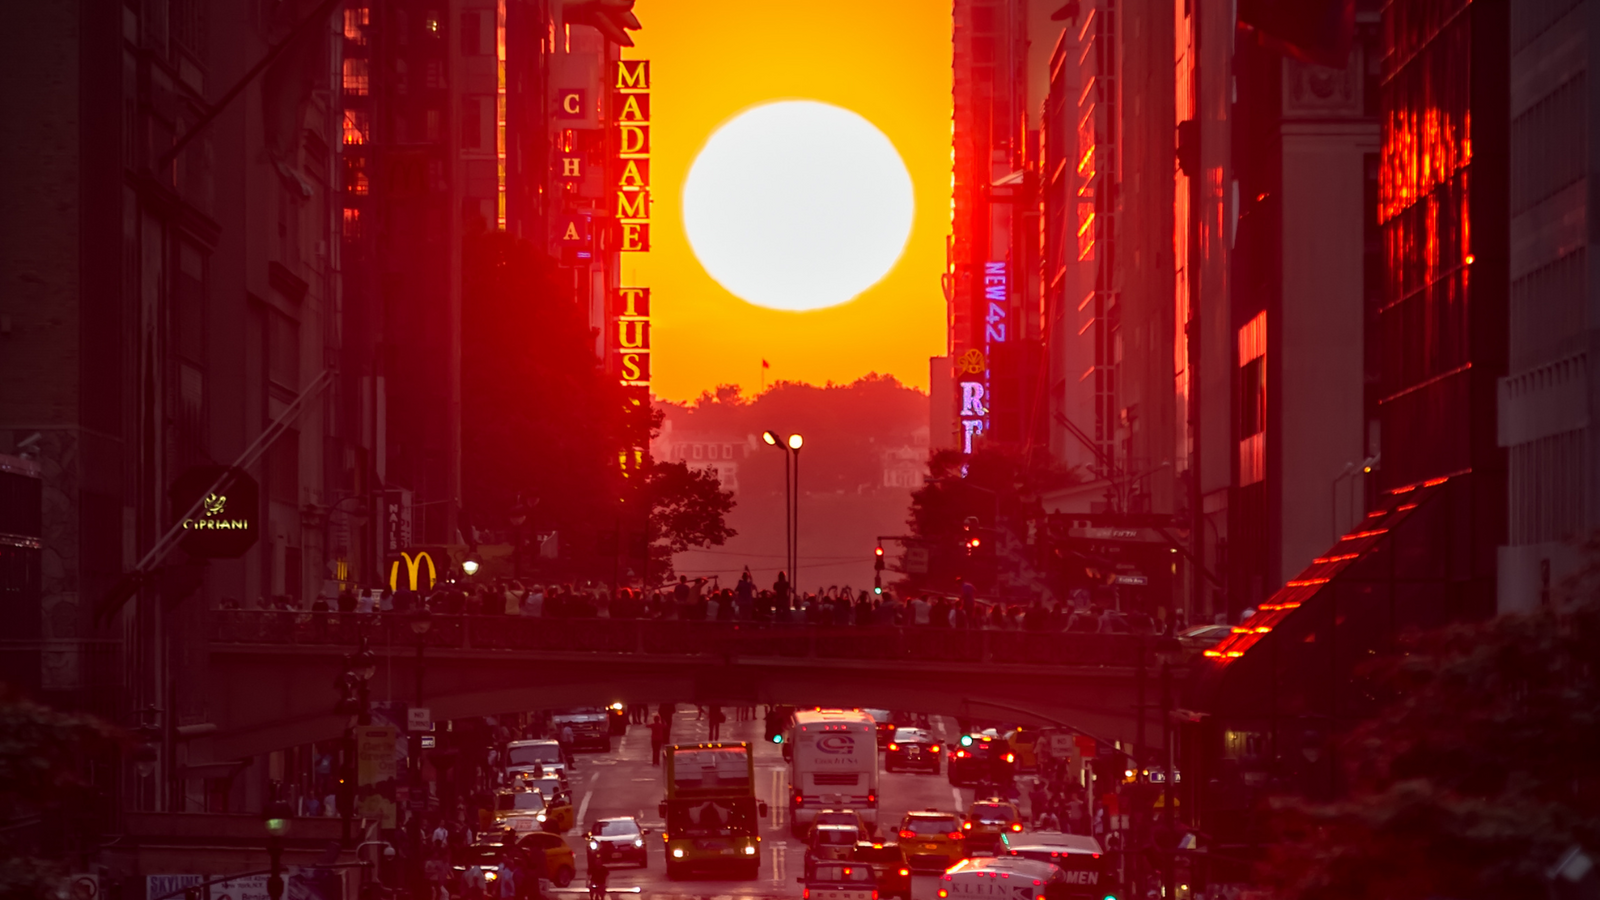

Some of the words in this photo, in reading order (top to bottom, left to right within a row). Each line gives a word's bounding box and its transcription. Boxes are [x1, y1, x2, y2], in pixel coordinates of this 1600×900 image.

[615, 61, 647, 251] MADAME
[985, 262, 1005, 300] NEW
[388, 503, 398, 550] NAILS
[1112, 530, 1137, 538] FIFTH
[414, 711, 425, 719] NO
[951, 883, 1007, 895] KLEIN
